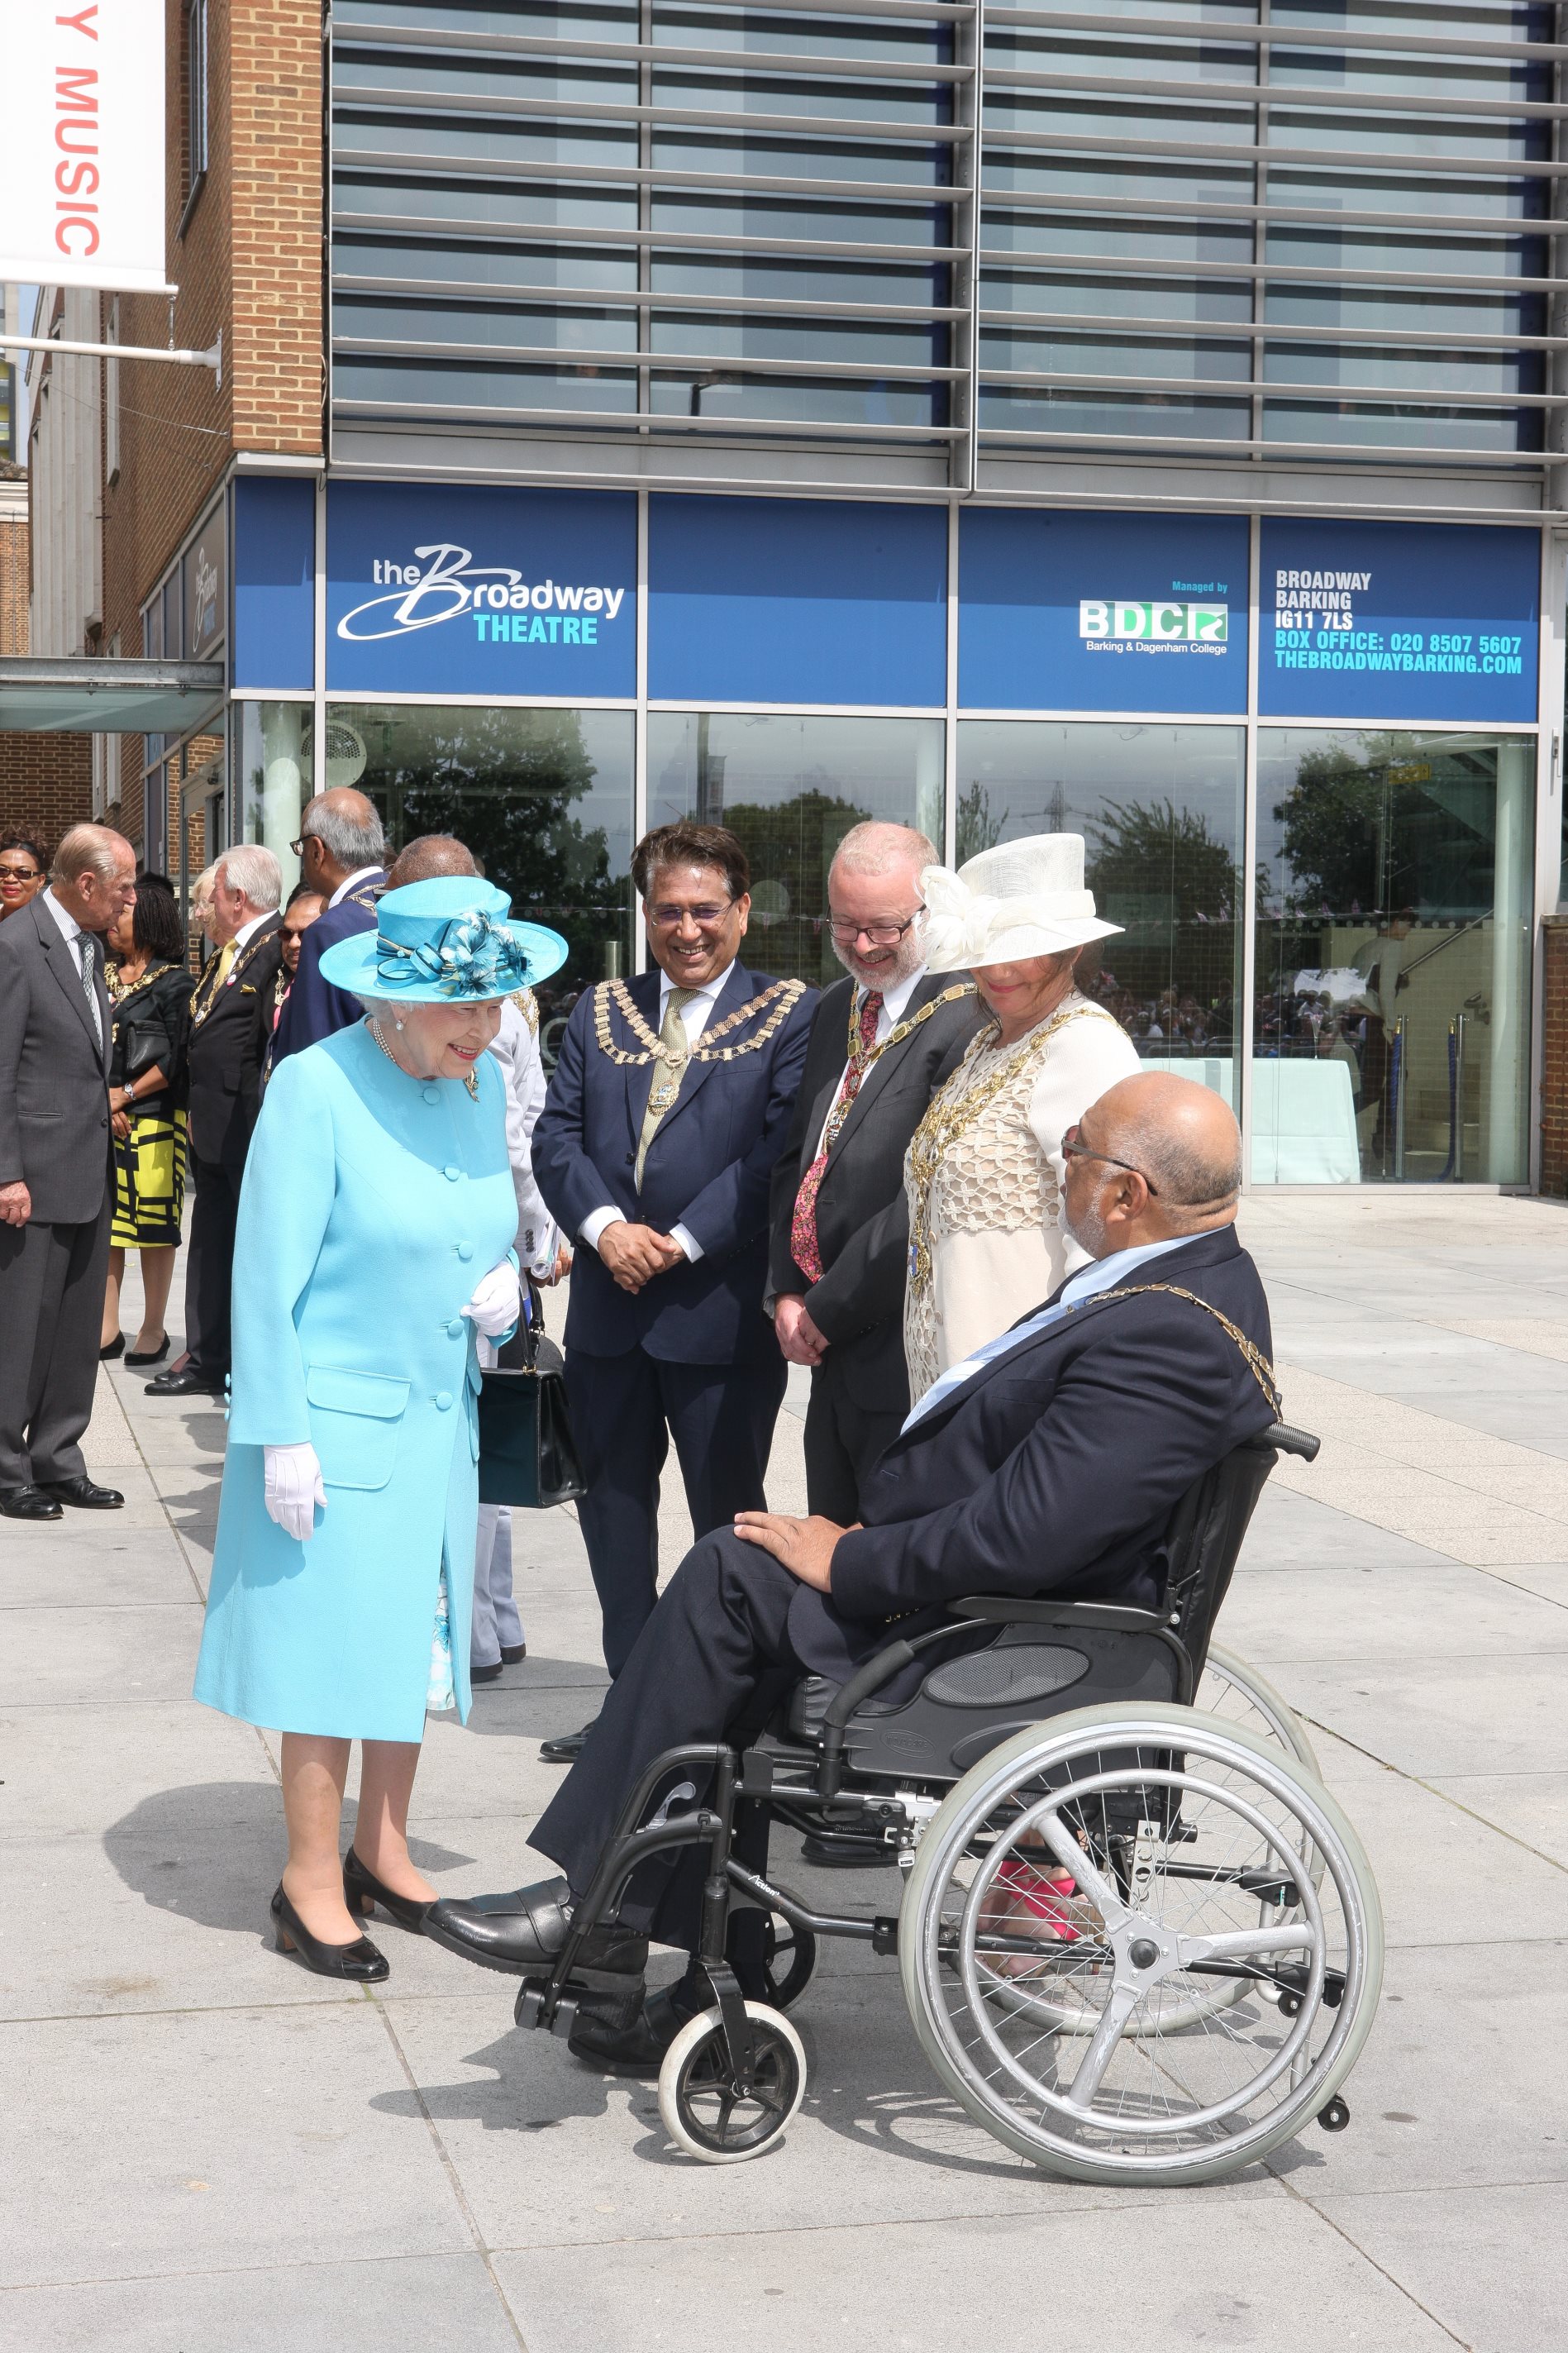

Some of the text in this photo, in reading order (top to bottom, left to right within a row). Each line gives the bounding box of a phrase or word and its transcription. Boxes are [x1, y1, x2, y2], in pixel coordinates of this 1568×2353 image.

[55, 66, 100, 256] MUSIC
[1172, 581, 1228, 594] Managed by
[1275, 570, 1372, 590] BROADWAY
[337, 543, 625, 641] the Broadway
[1275, 590, 1351, 609] BARKING
[473, 613, 598, 644] THEATRE
[1275, 610, 1353, 630] IG11 7LS
[1086, 641, 1227, 656] Barking & Dagenham College
[1275, 631, 1522, 654] BOX OFFICE: 020 8507 5607
[1275, 651, 1522, 674] THEBROADWAYBARKING.COM
